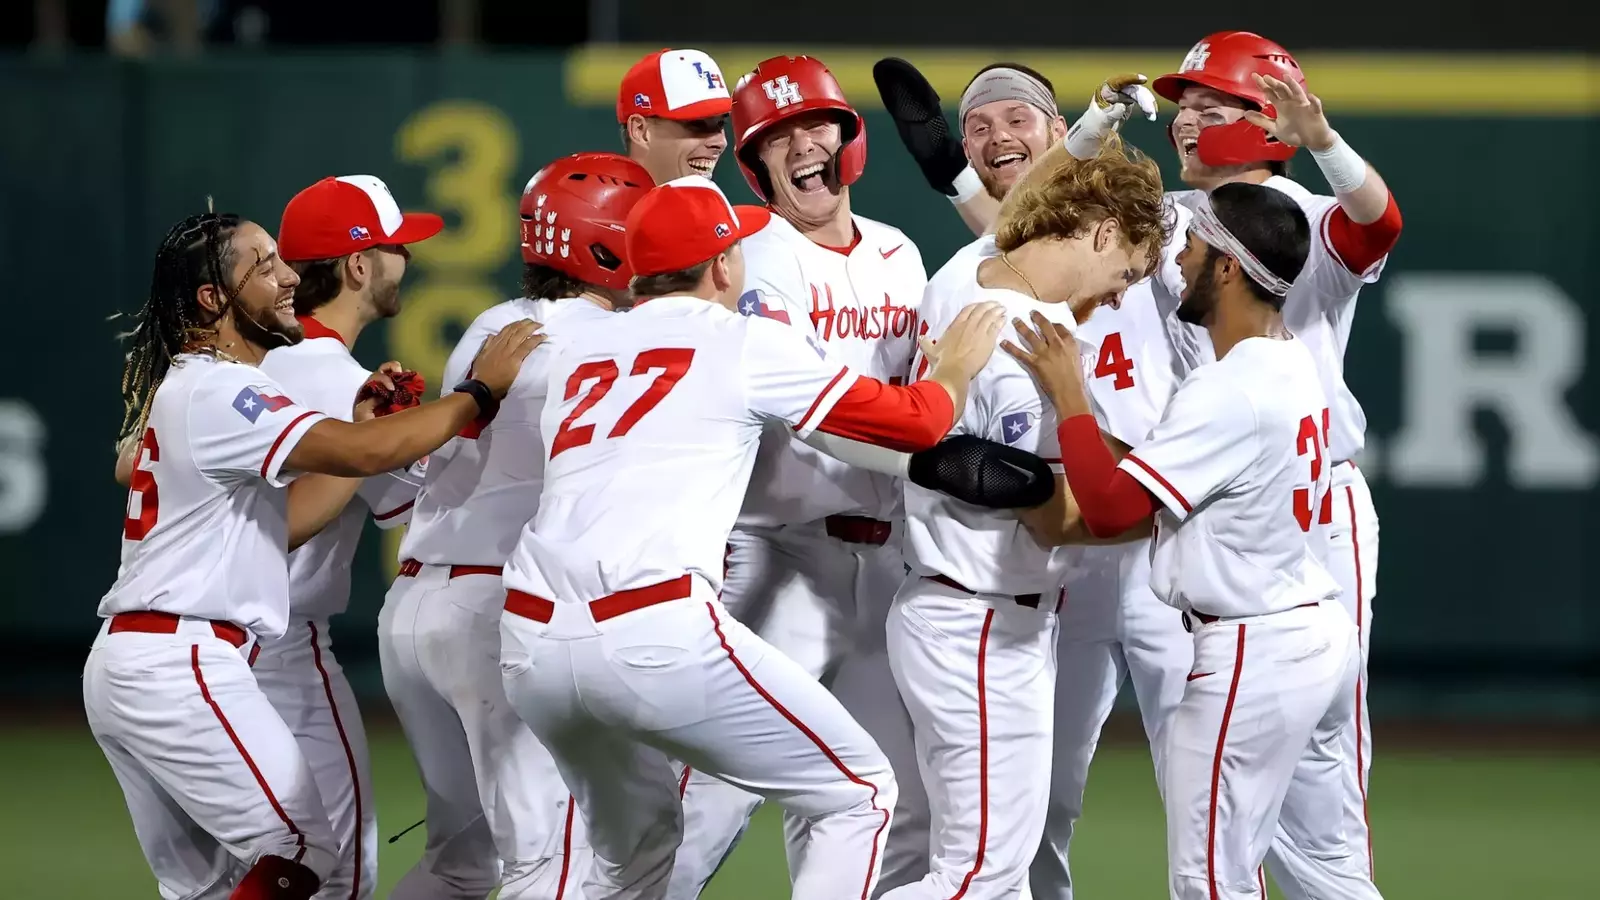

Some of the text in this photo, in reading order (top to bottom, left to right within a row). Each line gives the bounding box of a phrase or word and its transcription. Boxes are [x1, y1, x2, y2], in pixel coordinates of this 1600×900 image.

[761, 74, 804, 110] UH
[808, 281, 919, 344] Houston
[1094, 331, 1135, 391] 4
[1364, 272, 1600, 489] R
[549, 347, 696, 462] 27
